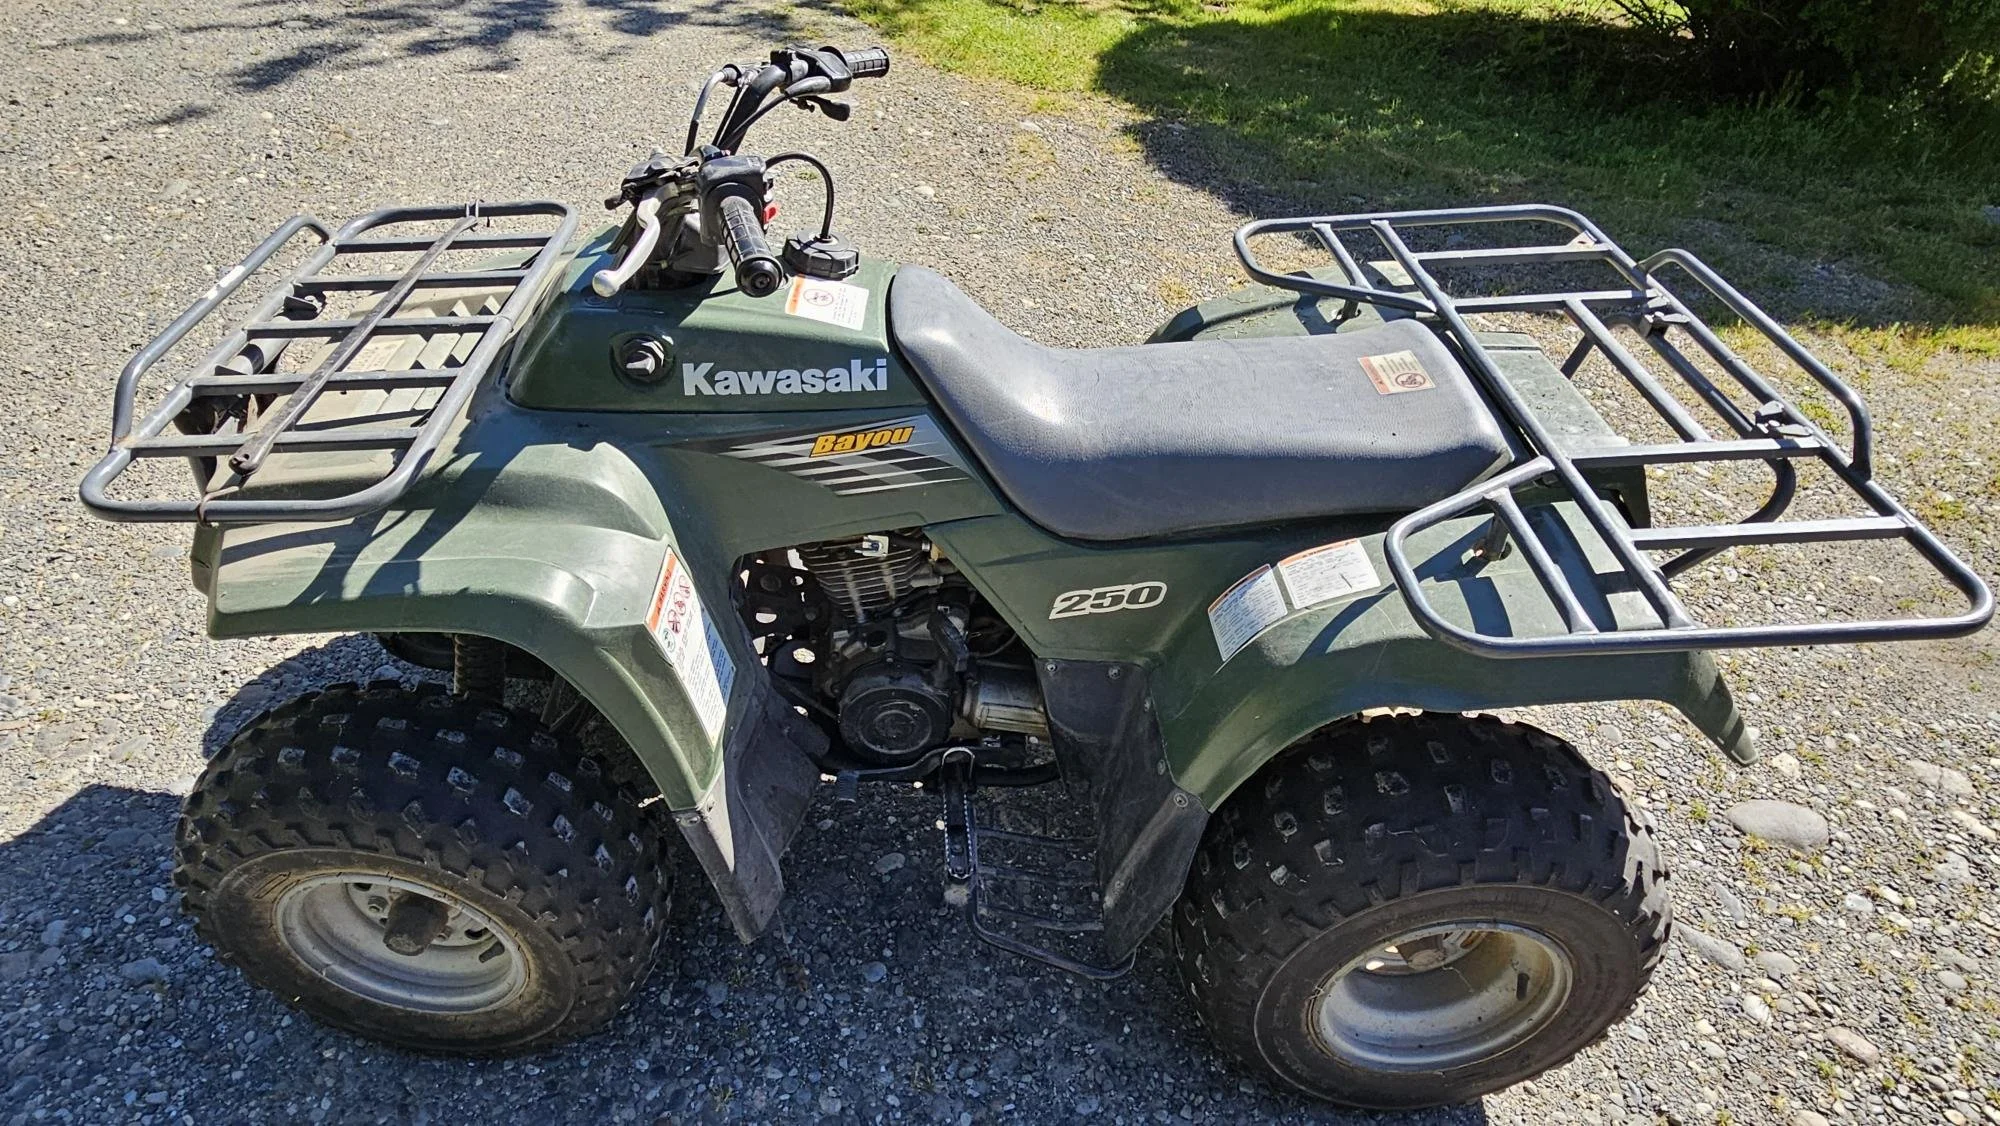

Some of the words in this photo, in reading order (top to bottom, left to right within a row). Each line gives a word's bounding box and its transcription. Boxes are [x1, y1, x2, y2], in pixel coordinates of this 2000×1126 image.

[682, 358, 887, 396] Kawasaki
[809, 426, 914, 458] Bayou
[1049, 581, 1168, 620] 250
